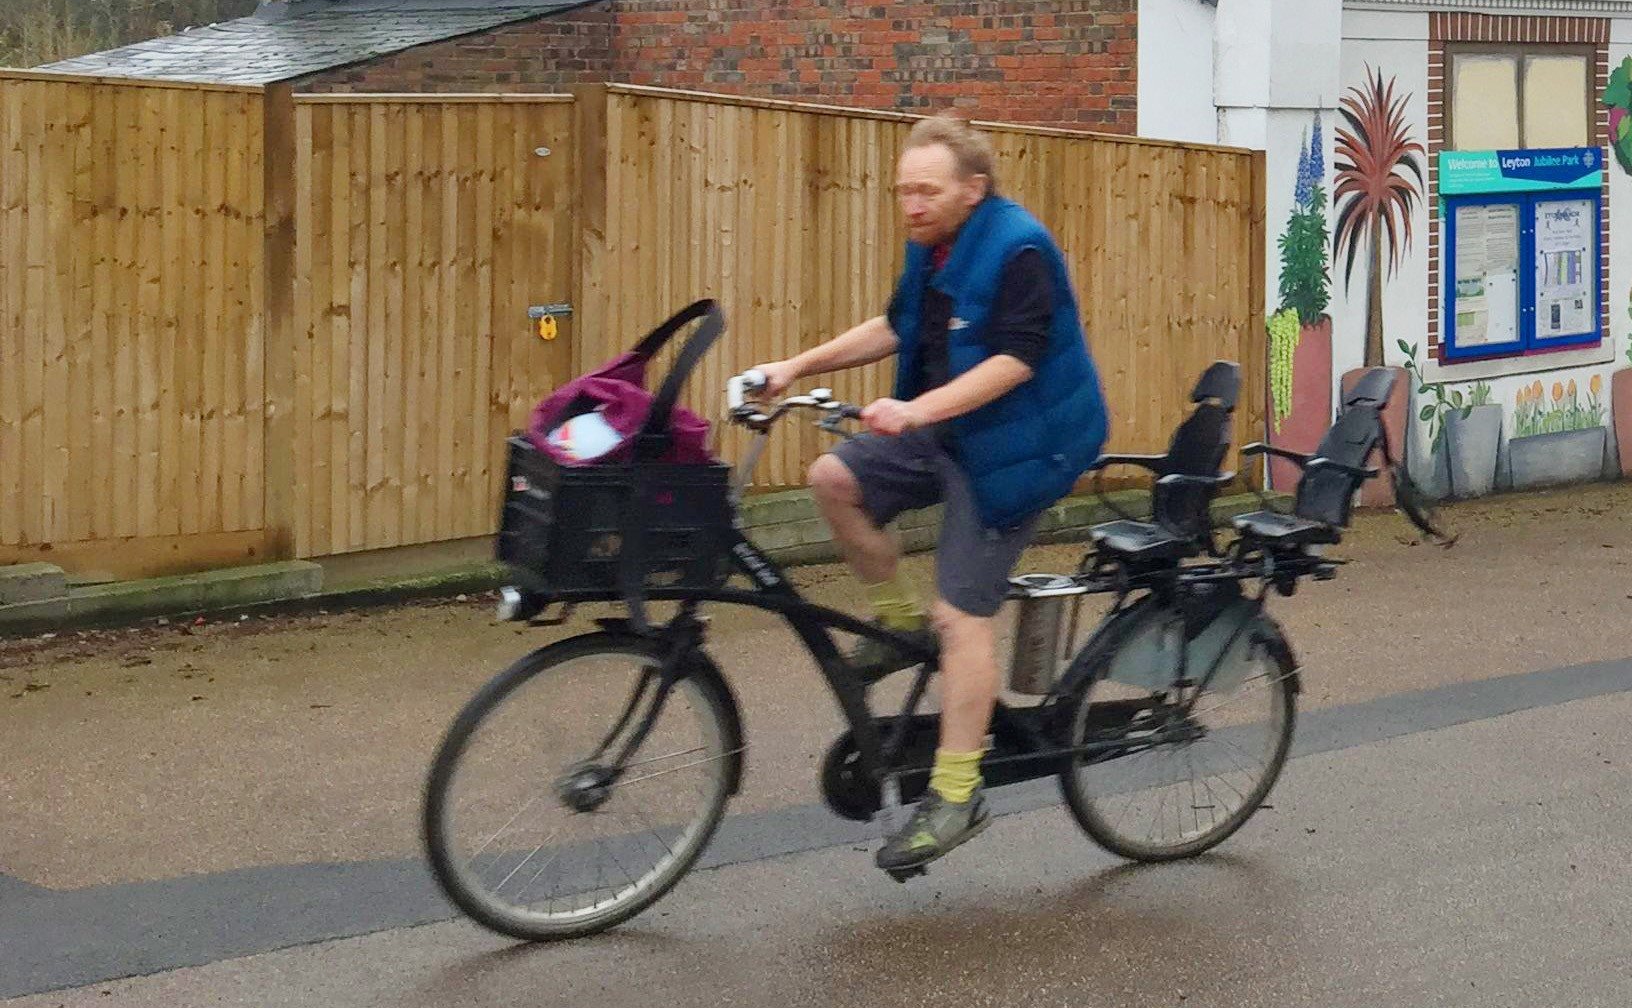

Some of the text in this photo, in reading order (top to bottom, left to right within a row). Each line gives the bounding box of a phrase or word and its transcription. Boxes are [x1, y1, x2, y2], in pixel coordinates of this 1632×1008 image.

[1448, 155, 1580, 170] Welcome to Leyton Jubilee Park
